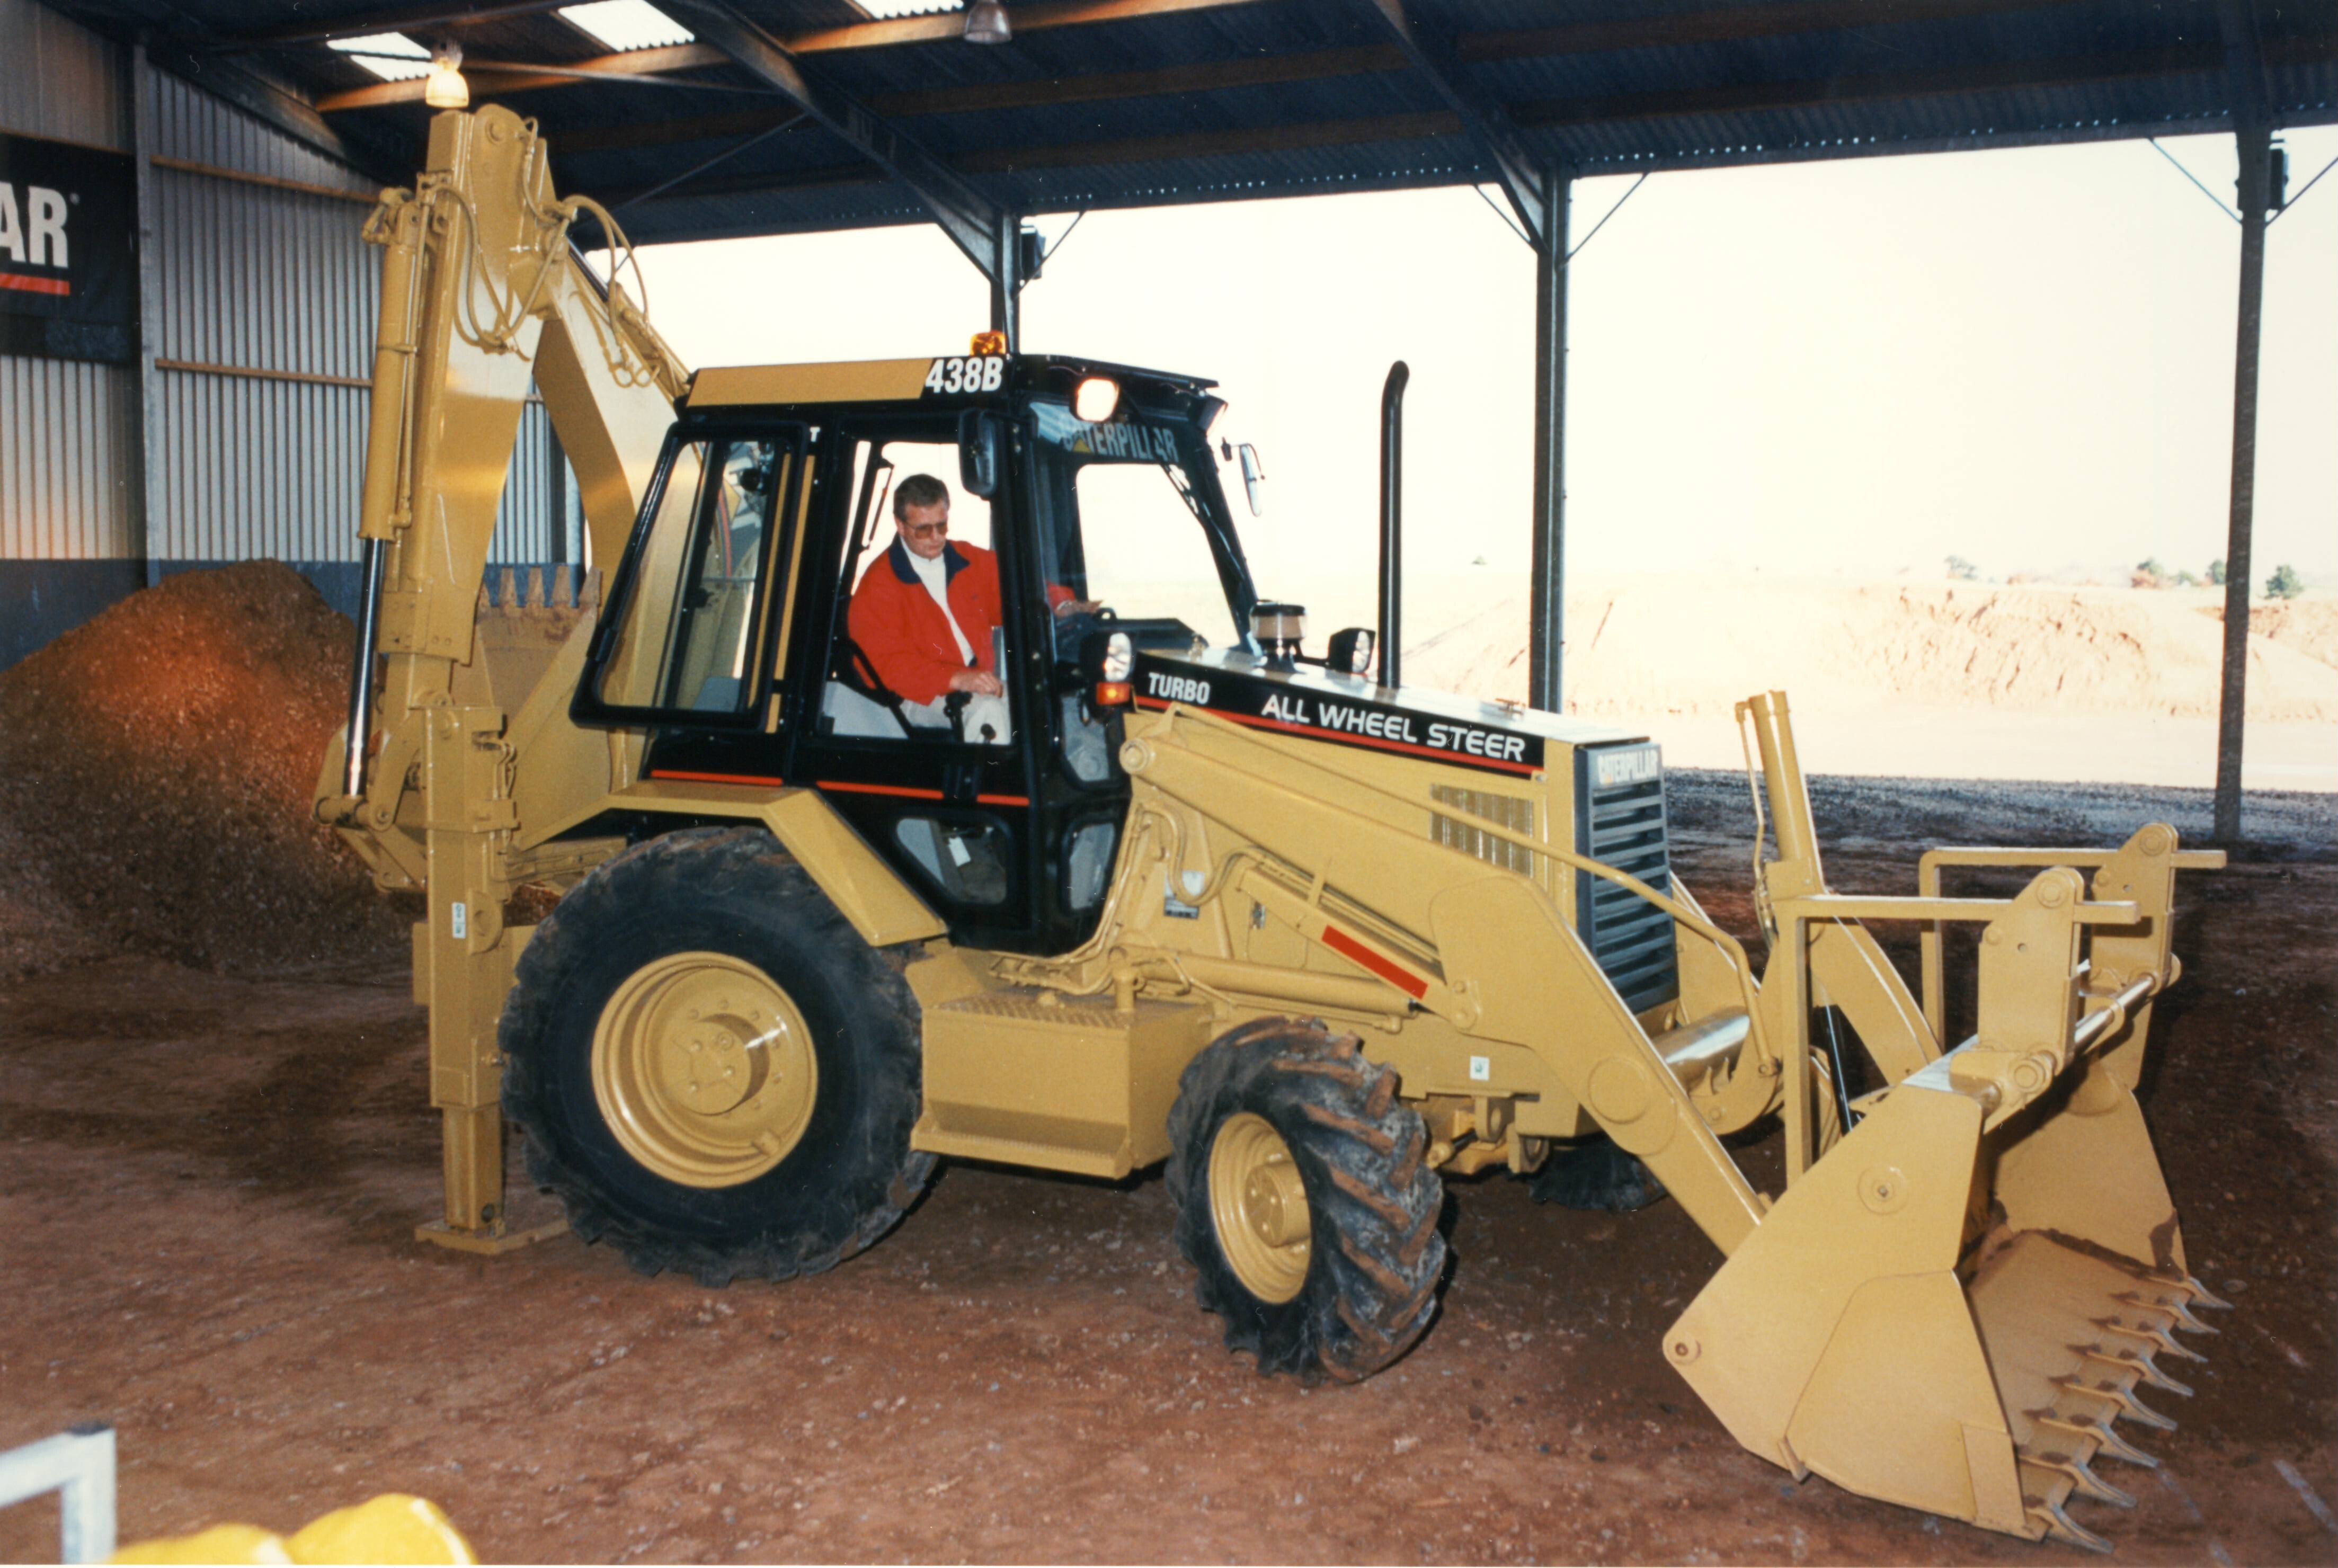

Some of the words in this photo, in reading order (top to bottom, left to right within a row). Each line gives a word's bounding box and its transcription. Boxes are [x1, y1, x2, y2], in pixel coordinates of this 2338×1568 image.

[926, 357, 1003, 393] 438B
[1148, 672, 1210, 705] TURBO
[1261, 694, 1311, 724] ALL
[1318, 702, 1418, 744] WHEEL
[1427, 724, 1525, 763] STEER
